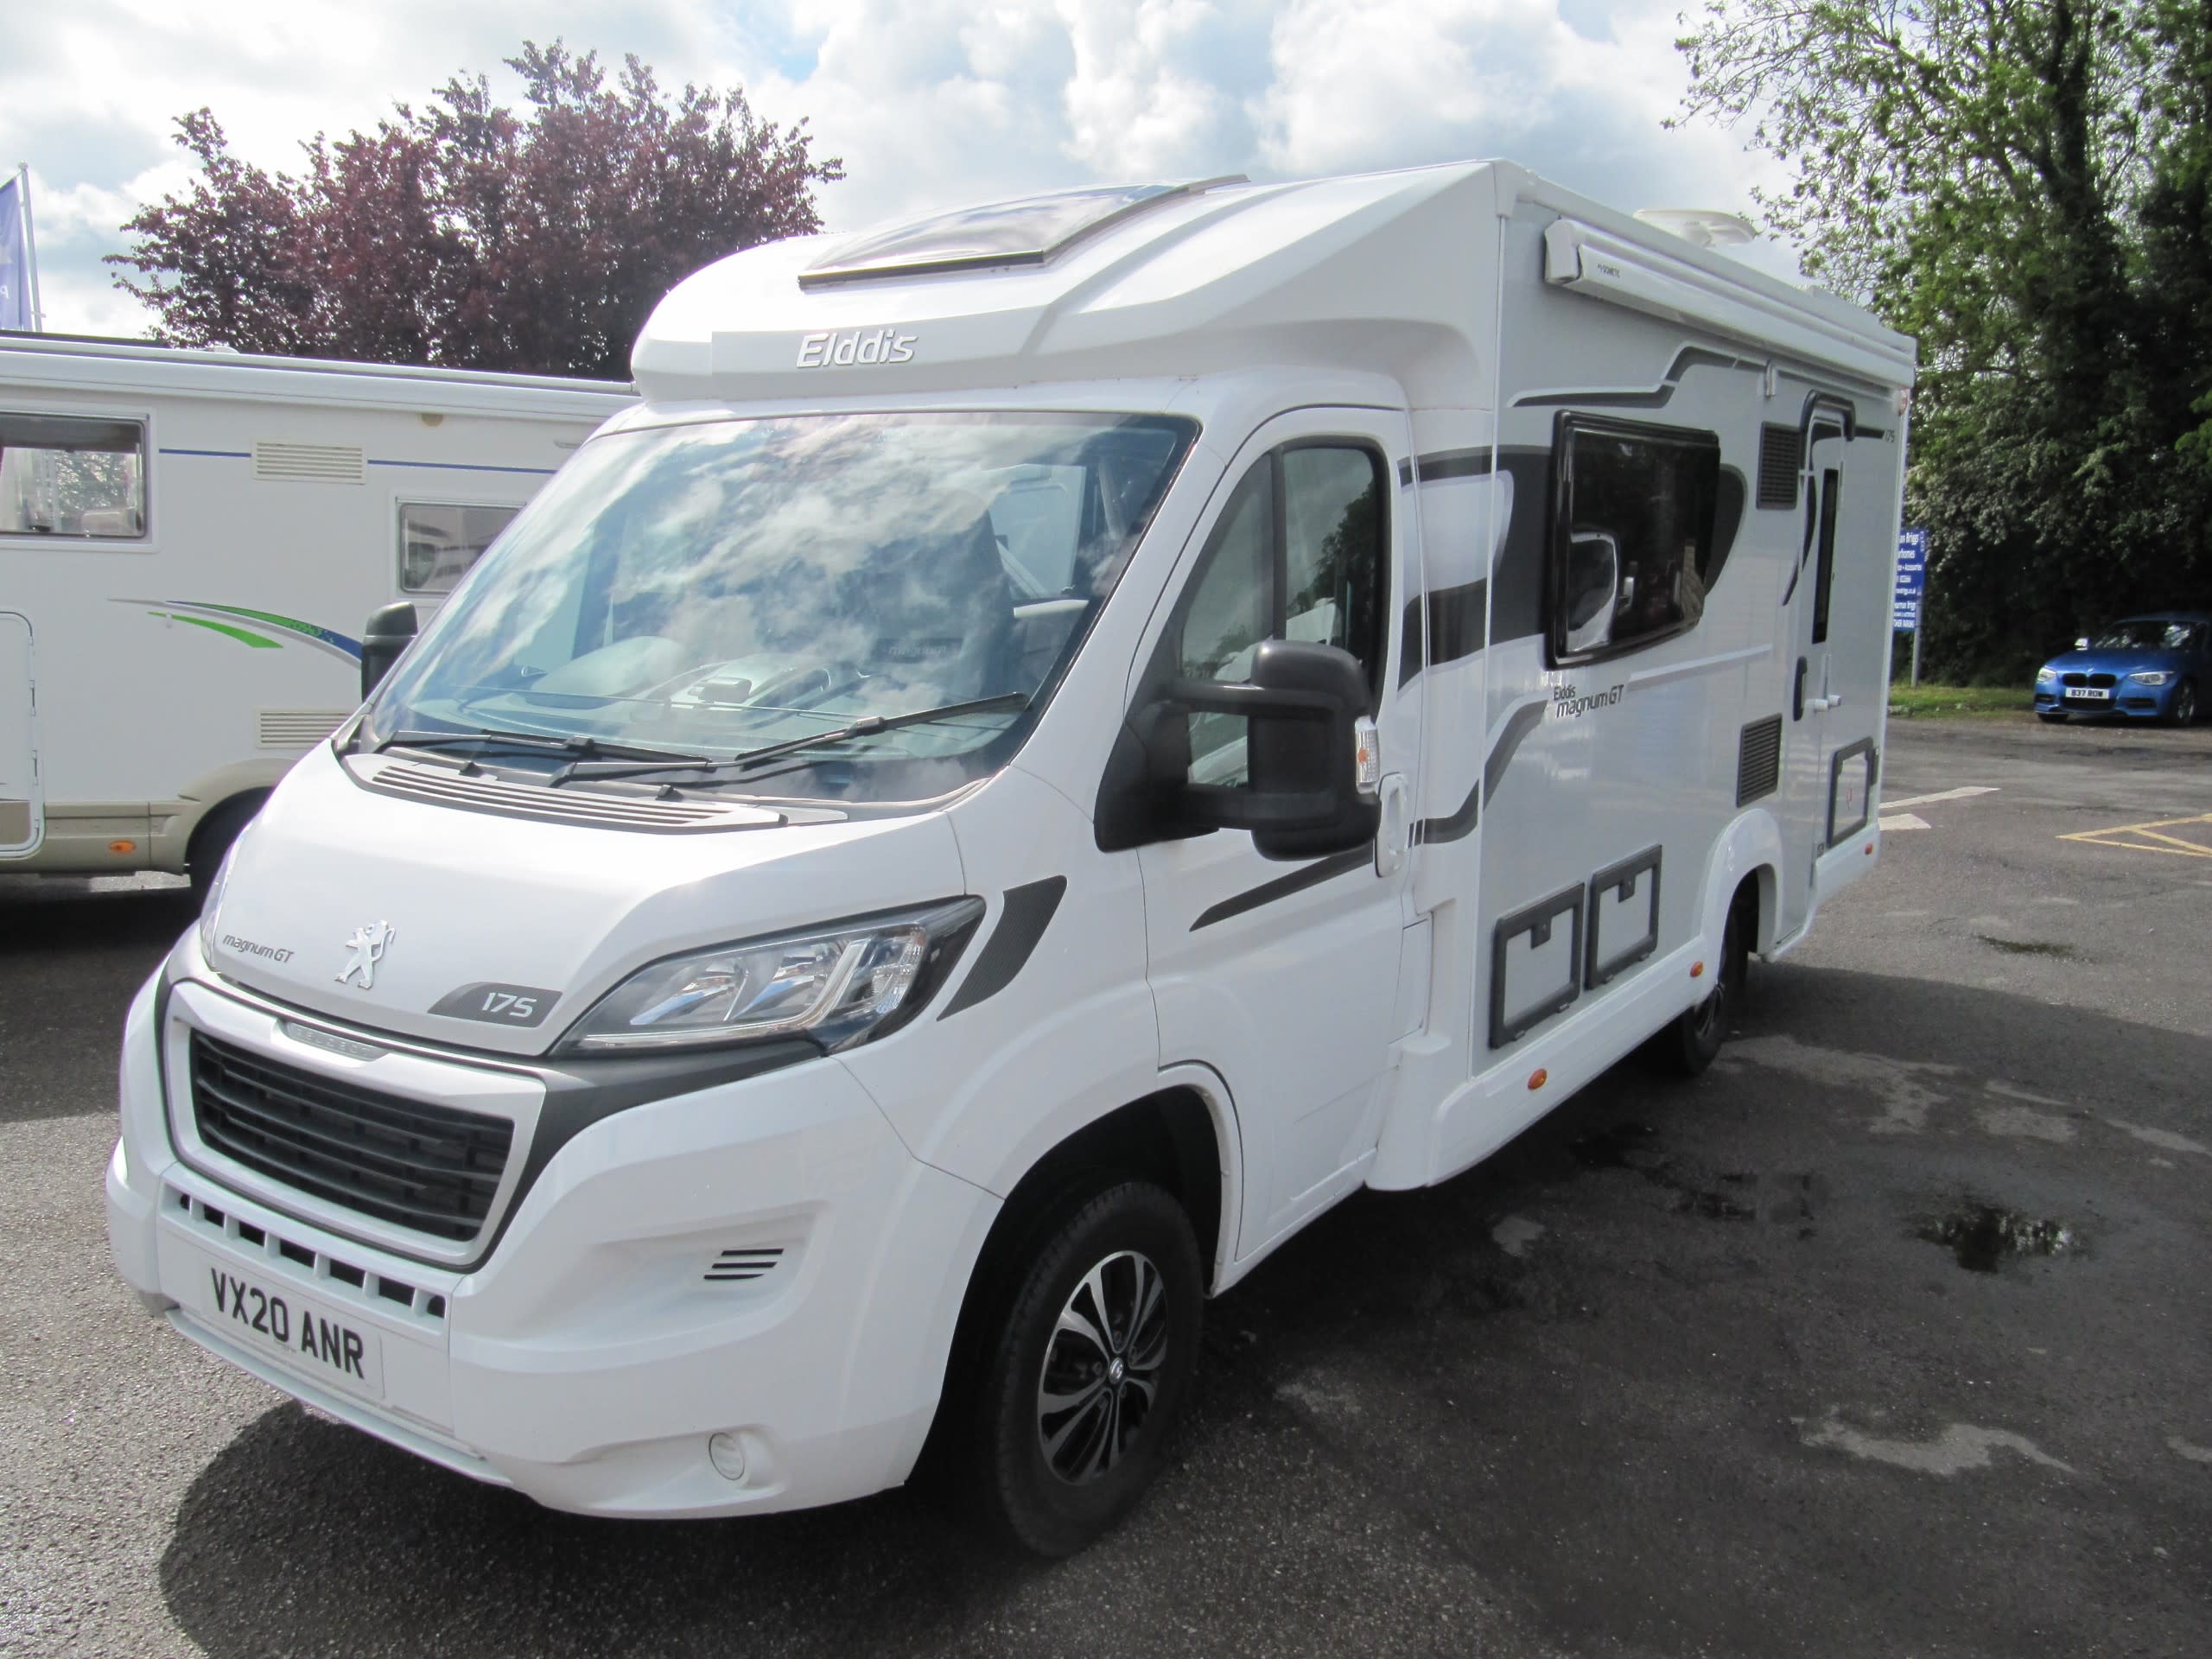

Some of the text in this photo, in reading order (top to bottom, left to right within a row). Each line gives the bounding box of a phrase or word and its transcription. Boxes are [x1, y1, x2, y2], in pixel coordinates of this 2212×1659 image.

[797, 328, 918, 368] Elddis
[1554, 684, 1576, 701] Elddis
[482, 992, 537, 1018] 175
[211, 1267, 365, 1380] VX20 ANR
